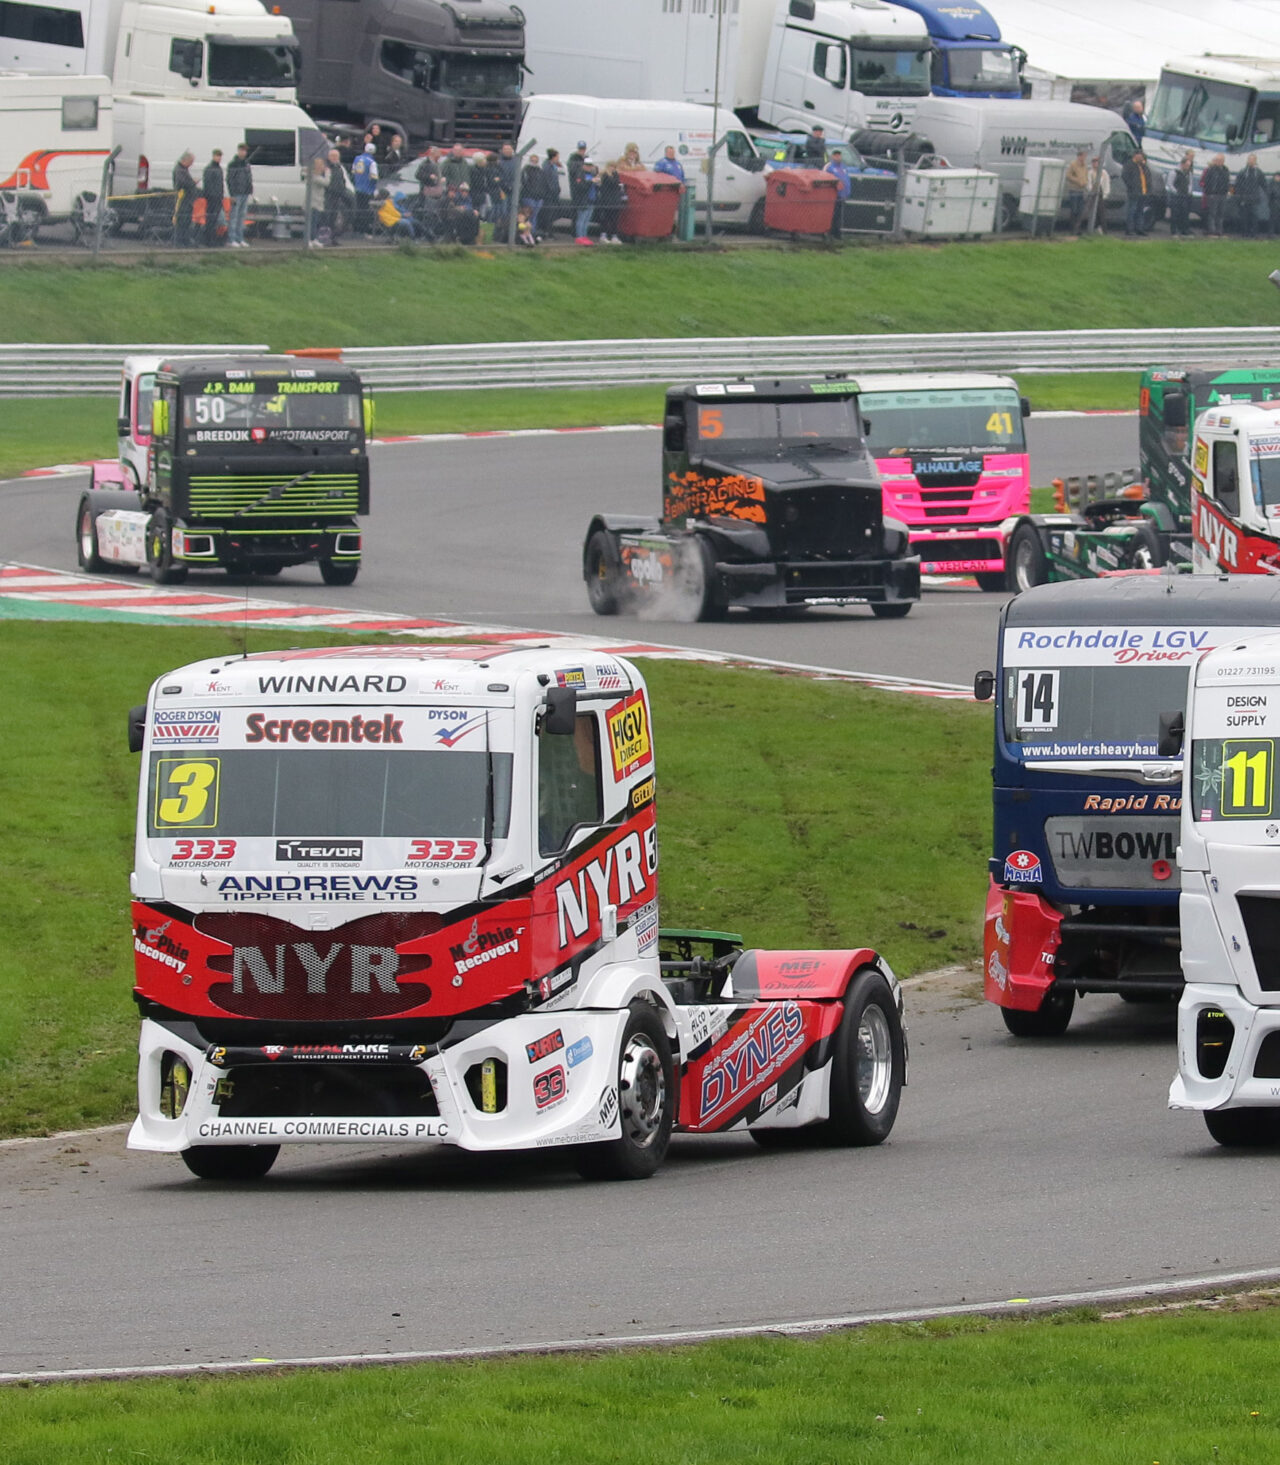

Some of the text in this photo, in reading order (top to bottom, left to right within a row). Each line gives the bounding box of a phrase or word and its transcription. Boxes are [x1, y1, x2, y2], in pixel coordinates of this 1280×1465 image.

[229, 382, 256, 393] DAM
[277, 382, 340, 393] TRANSPORT
[195, 397, 225, 424] 50
[699, 410, 724, 439] 5
[986, 412, 1013, 434] 41
[269, 430, 350, 441] AUTOTRANSPORT
[1200, 504, 1238, 568] NYR
[1017, 630, 1208, 649] Rochdale LGV
[1114, 648, 1194, 664] Driver
[1217, 666, 1275, 676] 01227 731195
[258, 675, 407, 694] WINNARD
[1021, 672, 1055, 724] 14
[1226, 696, 1267, 707] DESIGN
[154, 711, 221, 724] ROGER DYSON
[428, 710, 467, 720] DYSON
[1226, 716, 1267, 727] SUPPLY
[245, 713, 403, 743] Screentek
[612, 706, 642, 750] HGV
[619, 738, 642, 763] DIRECT
[1227, 750, 1268, 807] 11
[158, 762, 215, 823] 3
[633, 787, 650, 805] Giti
[1084, 794, 1148, 813] Rapid
[171, 840, 237, 860] 333
[407, 840, 478, 861] 333
[1004, 863, 1042, 882] MAHA
[218, 875, 418, 892] ANDREWS
[555, 830, 646, 950] NYR
[219, 891, 418, 901] TIPPER HIRE LTD
[134, 937, 187, 974] Recovery
[454, 938, 520, 975] Recovery
[232, 943, 400, 994] NYR
[692, 1024, 709, 1045] NYR
[700, 1000, 803, 1119] DYNES
[534, 1065, 566, 1105] 3G
[600, 1088, 618, 1124] MEI
[199, 1122, 449, 1138] CHANNEL COMMERCIALS PLC
